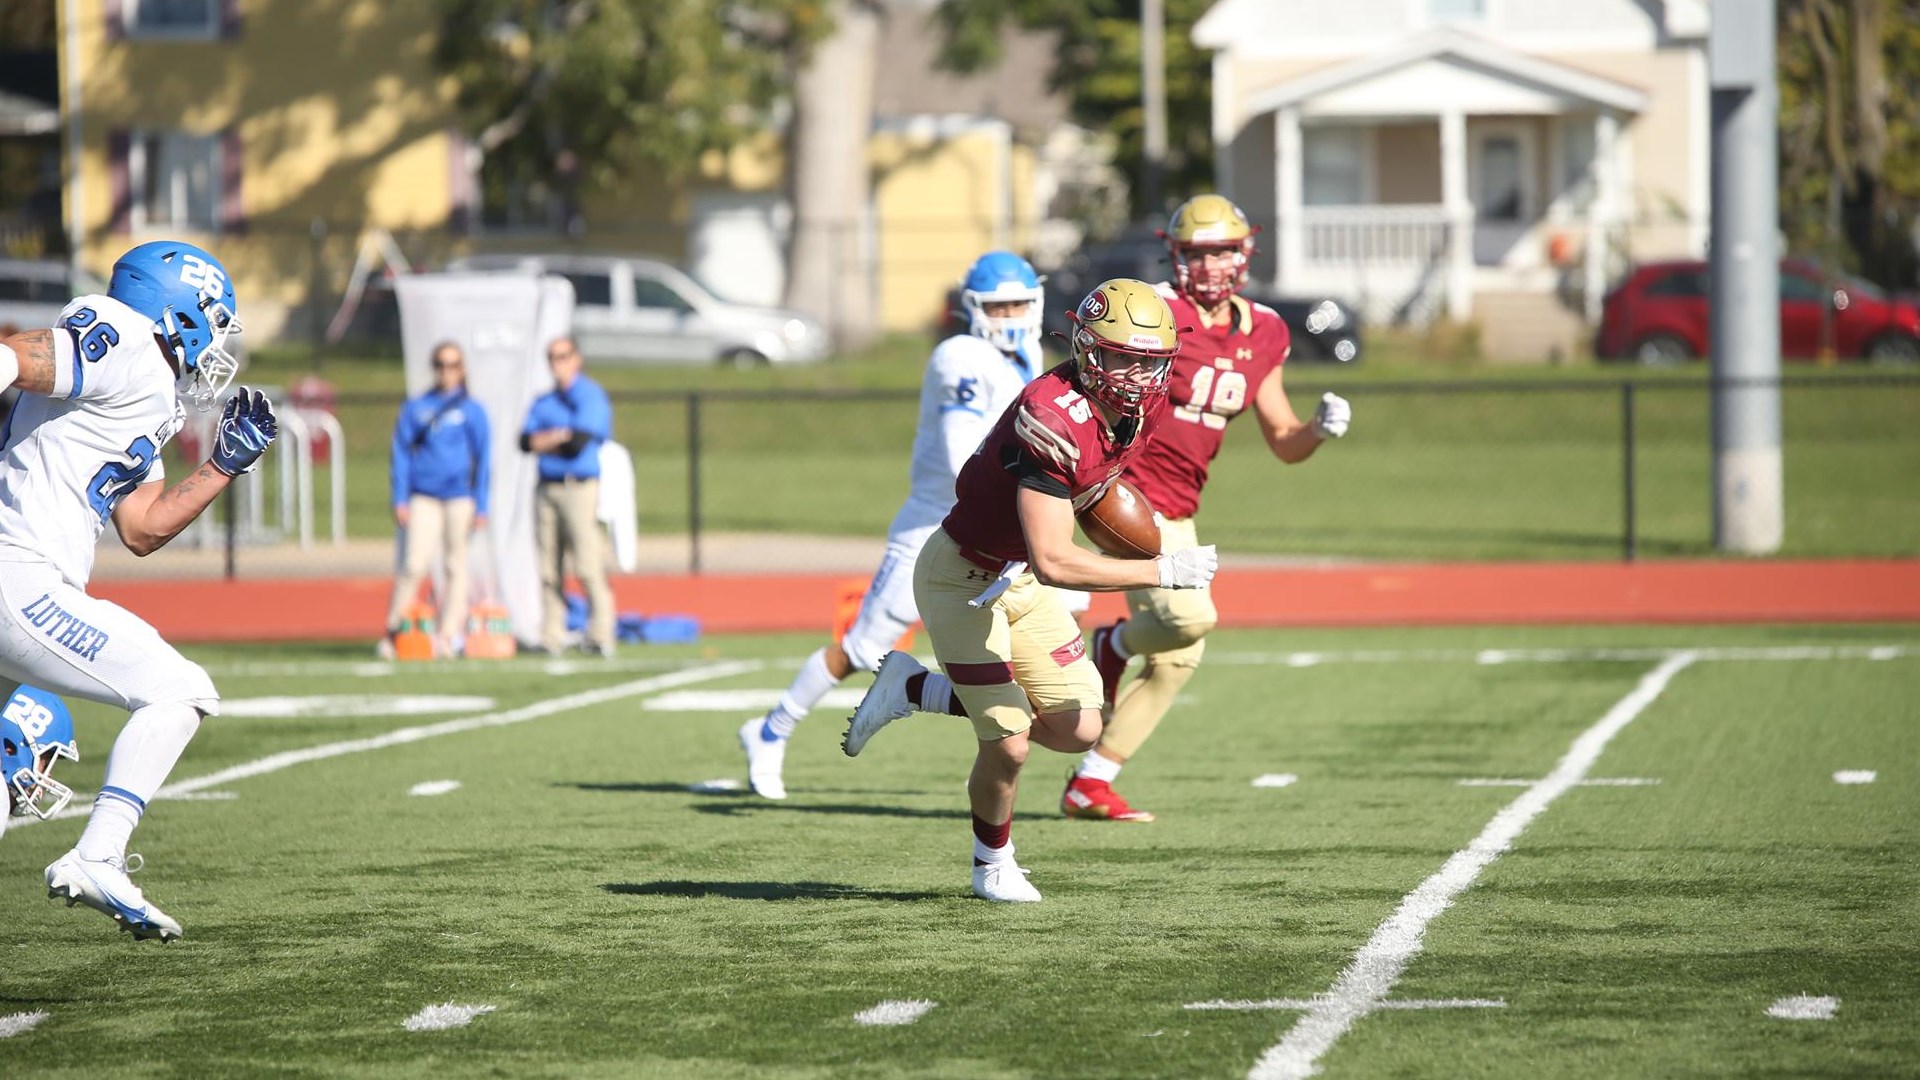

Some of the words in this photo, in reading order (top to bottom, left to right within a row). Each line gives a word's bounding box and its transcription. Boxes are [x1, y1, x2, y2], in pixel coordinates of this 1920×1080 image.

[180, 254, 225, 300] 26
[1084, 295, 1104, 316] OE
[66, 307, 120, 363] 26
[1053, 389, 1094, 425] 15
[21, 593, 109, 662] LUTHER
[2, 693, 53, 738] 28
